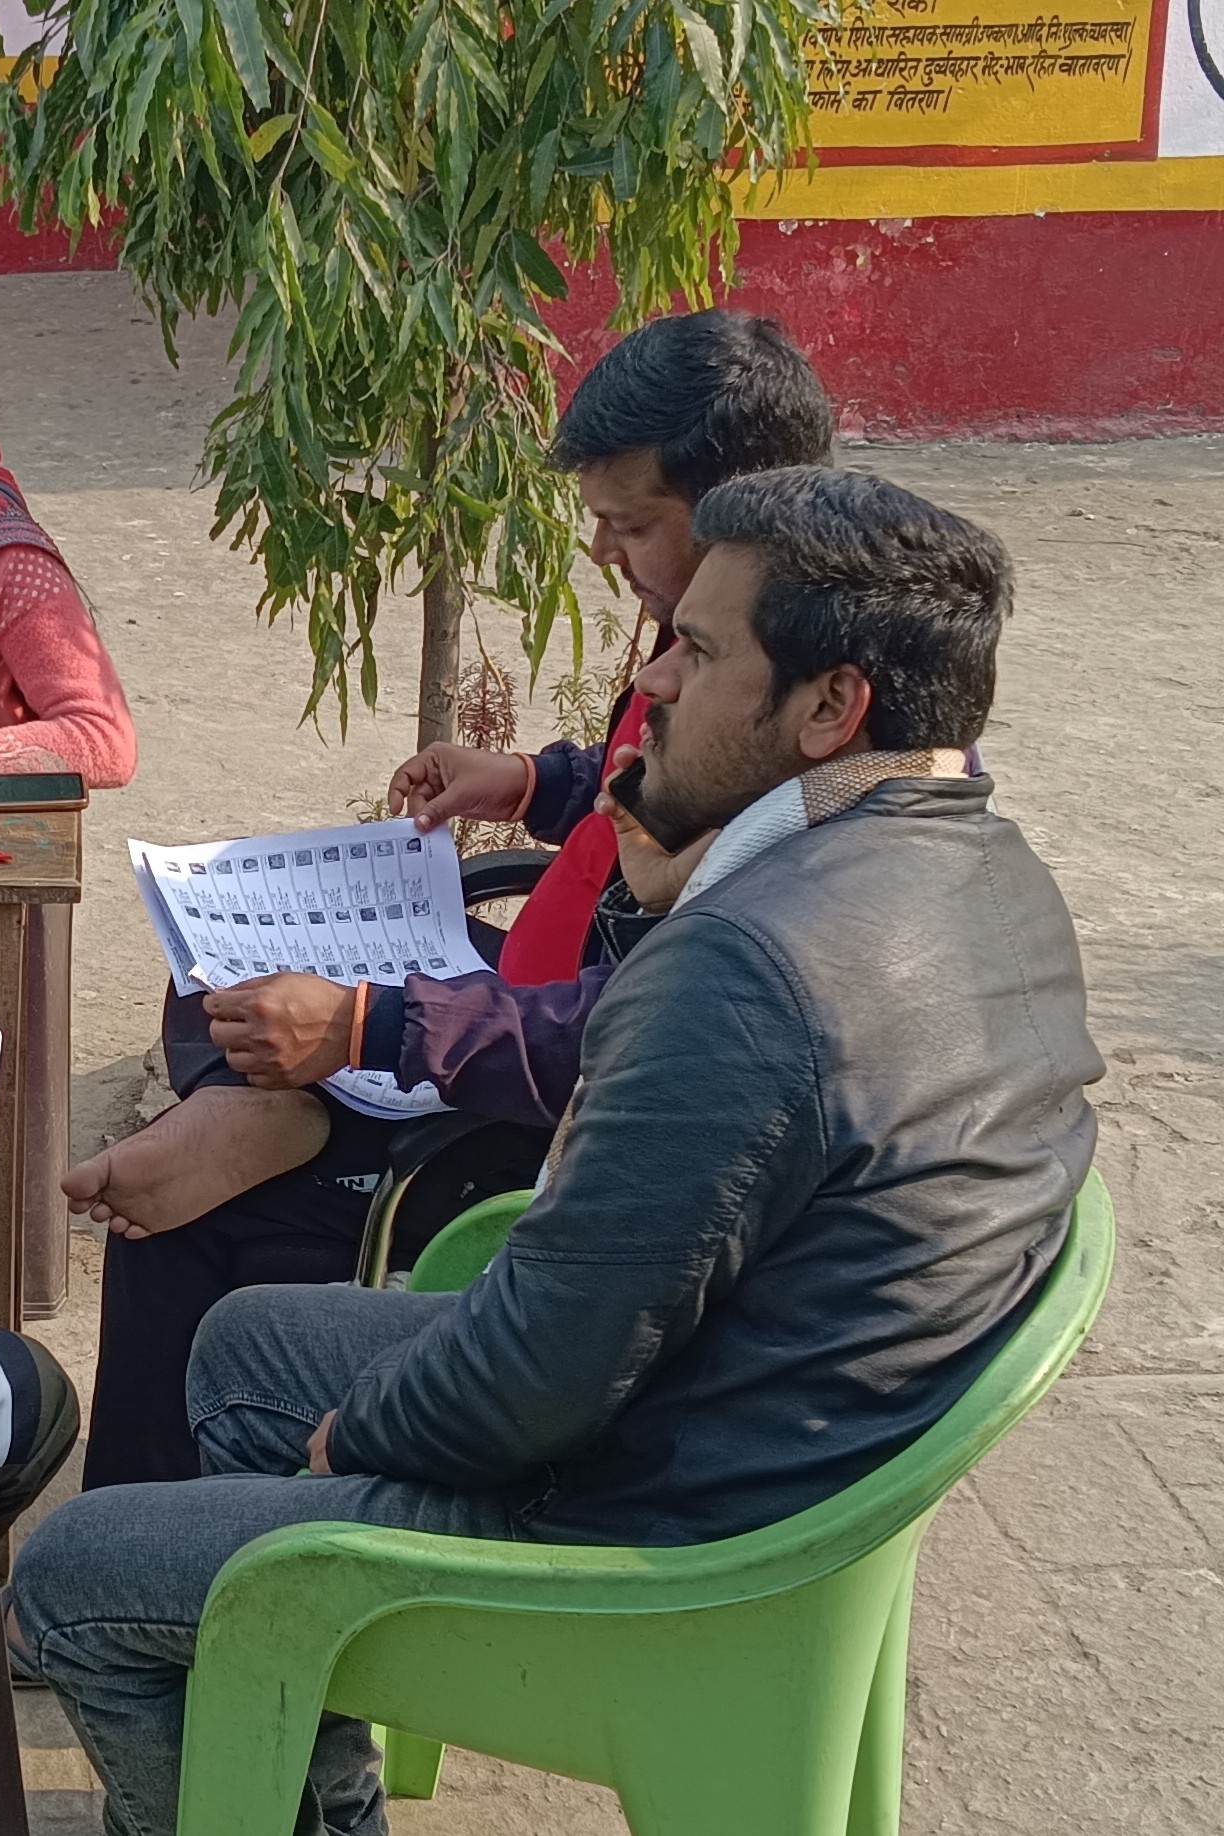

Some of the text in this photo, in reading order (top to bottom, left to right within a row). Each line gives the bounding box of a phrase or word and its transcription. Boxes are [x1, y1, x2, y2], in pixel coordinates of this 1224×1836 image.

[886, 25, 940, 49] सहायक
[939, 16, 981, 48] सामग्री
[1016, 15, 1046, 50] आदि
[848, 51, 923, 82] आधारित
[852, 89, 883, 112] का
